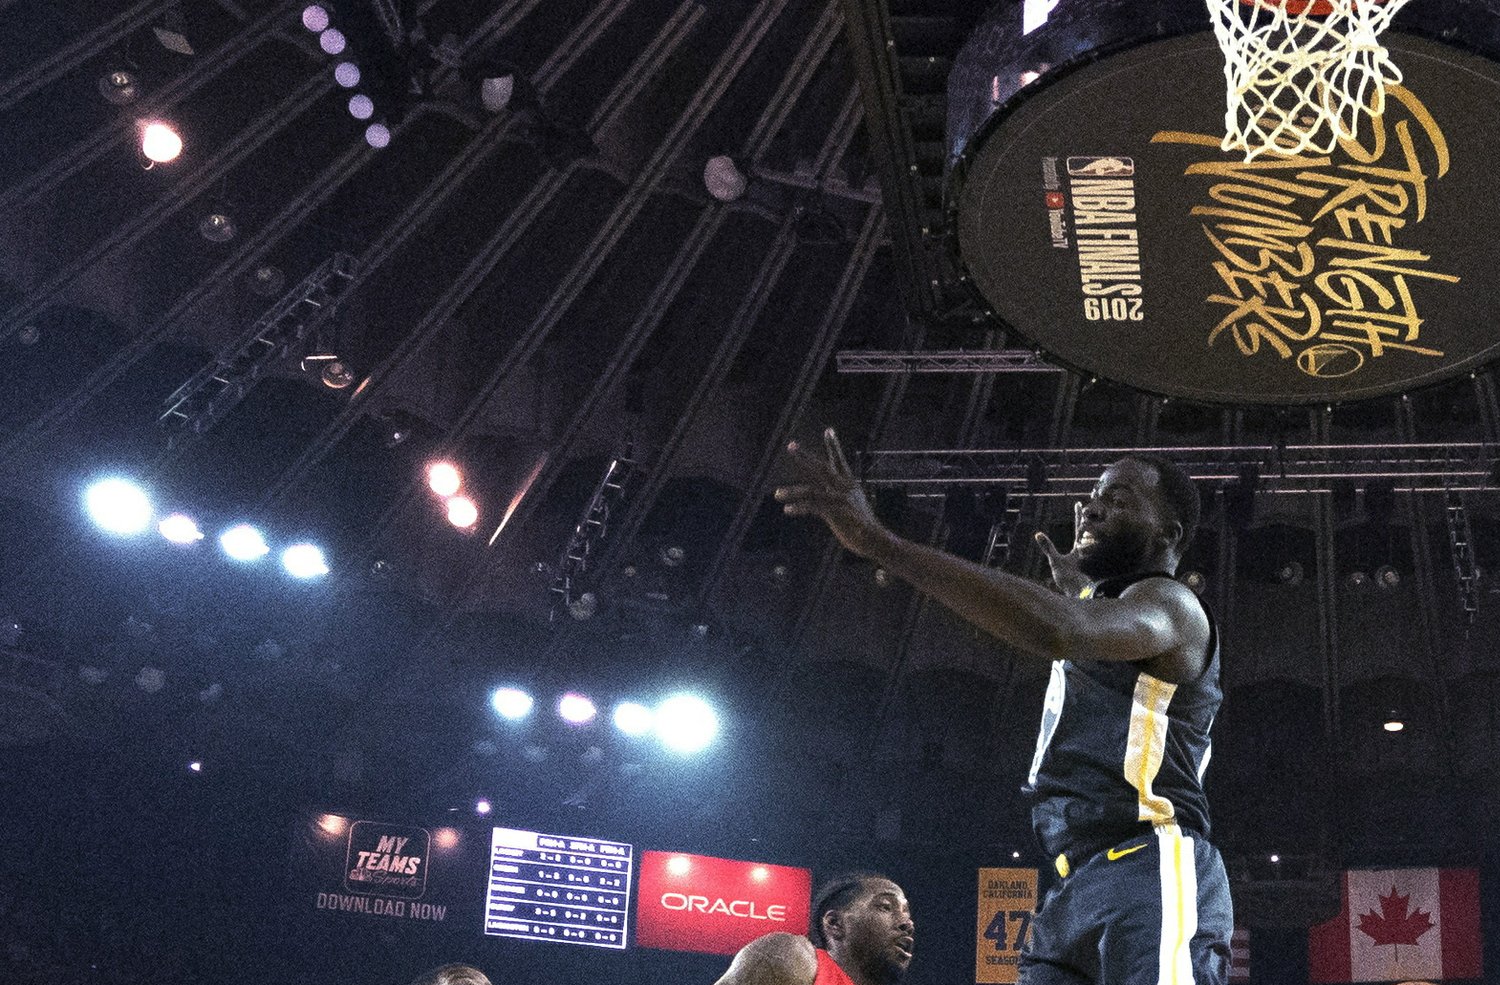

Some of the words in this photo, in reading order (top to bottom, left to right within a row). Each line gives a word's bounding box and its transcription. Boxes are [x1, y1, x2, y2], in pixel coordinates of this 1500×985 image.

[1070, 180, 1136, 224] NBA
[1151, 131, 1331, 358] NUMBERS
[1076, 229, 1142, 295] FINALS
[1084, 298, 1144, 321] 2019
[376, 836, 409, 854] MY
[356, 851, 421, 874] TEAMS
[983, 889, 1033, 898] CALIFORNIA
[988, 880, 1028, 889] OAKLAND
[317, 893, 405, 917] DOWNLOAD
[410, 902, 447, 921] NOW
[661, 892, 786, 921] ORACLE
[984, 910, 1032, 951] 47
